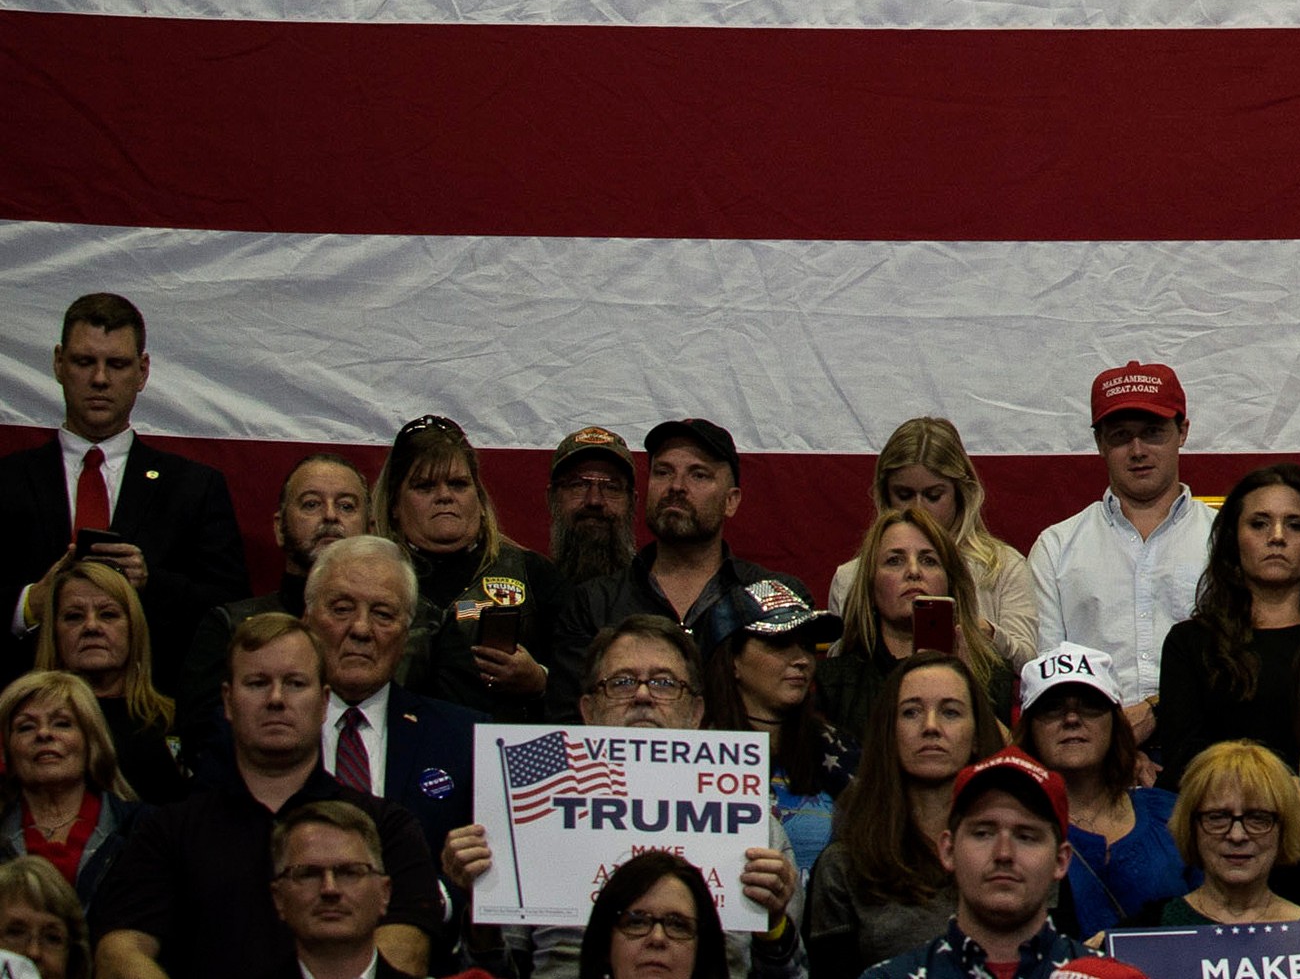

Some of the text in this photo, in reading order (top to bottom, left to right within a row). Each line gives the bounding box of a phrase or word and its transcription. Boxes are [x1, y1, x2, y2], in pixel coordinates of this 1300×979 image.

[1102, 374, 1163, 391] MAKE AMERICA
[1105, 385, 1159, 398] GREAT AGAIN
[1038, 654, 1096, 680] USA
[584, 737, 762, 766] VETERANS
[697, 772, 762, 796] FOR
[553, 797, 763, 834] TRUMP
